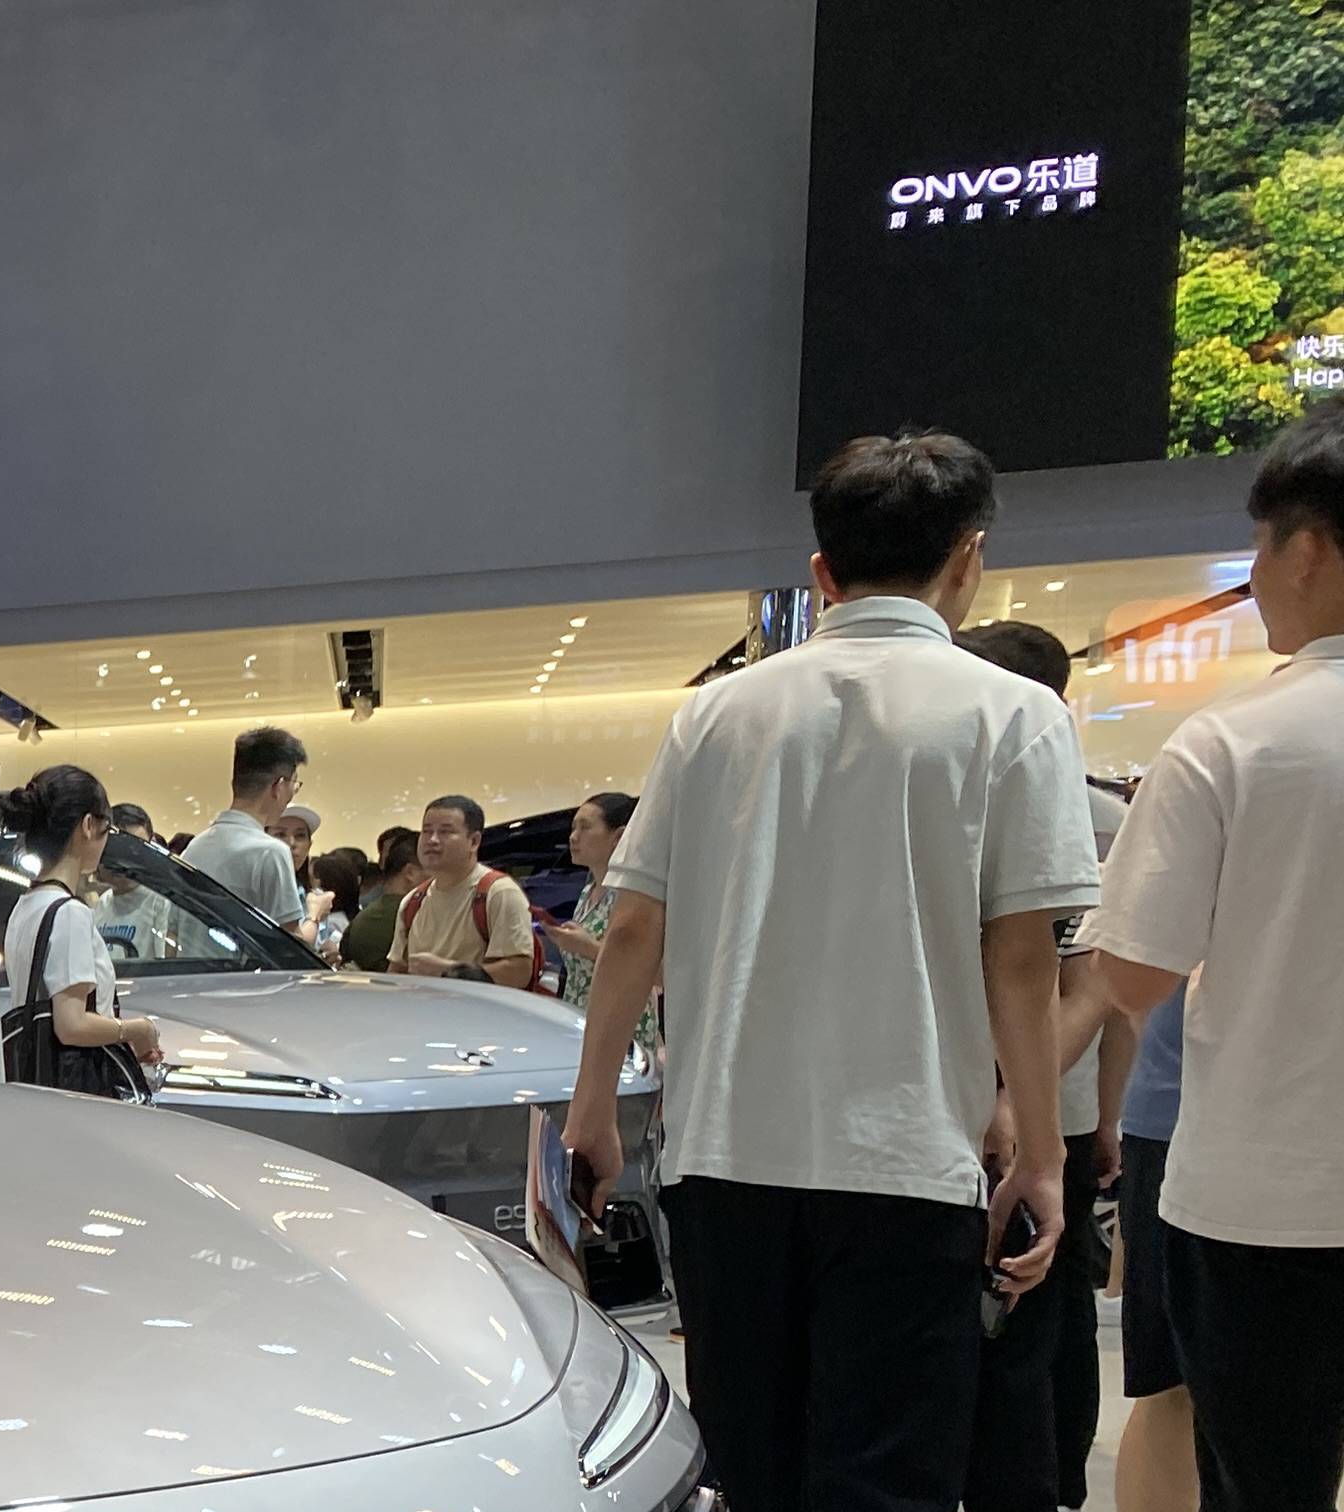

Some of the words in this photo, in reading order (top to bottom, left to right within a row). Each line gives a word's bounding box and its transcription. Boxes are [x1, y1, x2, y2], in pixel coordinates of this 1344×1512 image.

[891, 152, 1099, 205] ONVO乐道
[889, 190, 1097, 230] 蔚来旗下品牌
